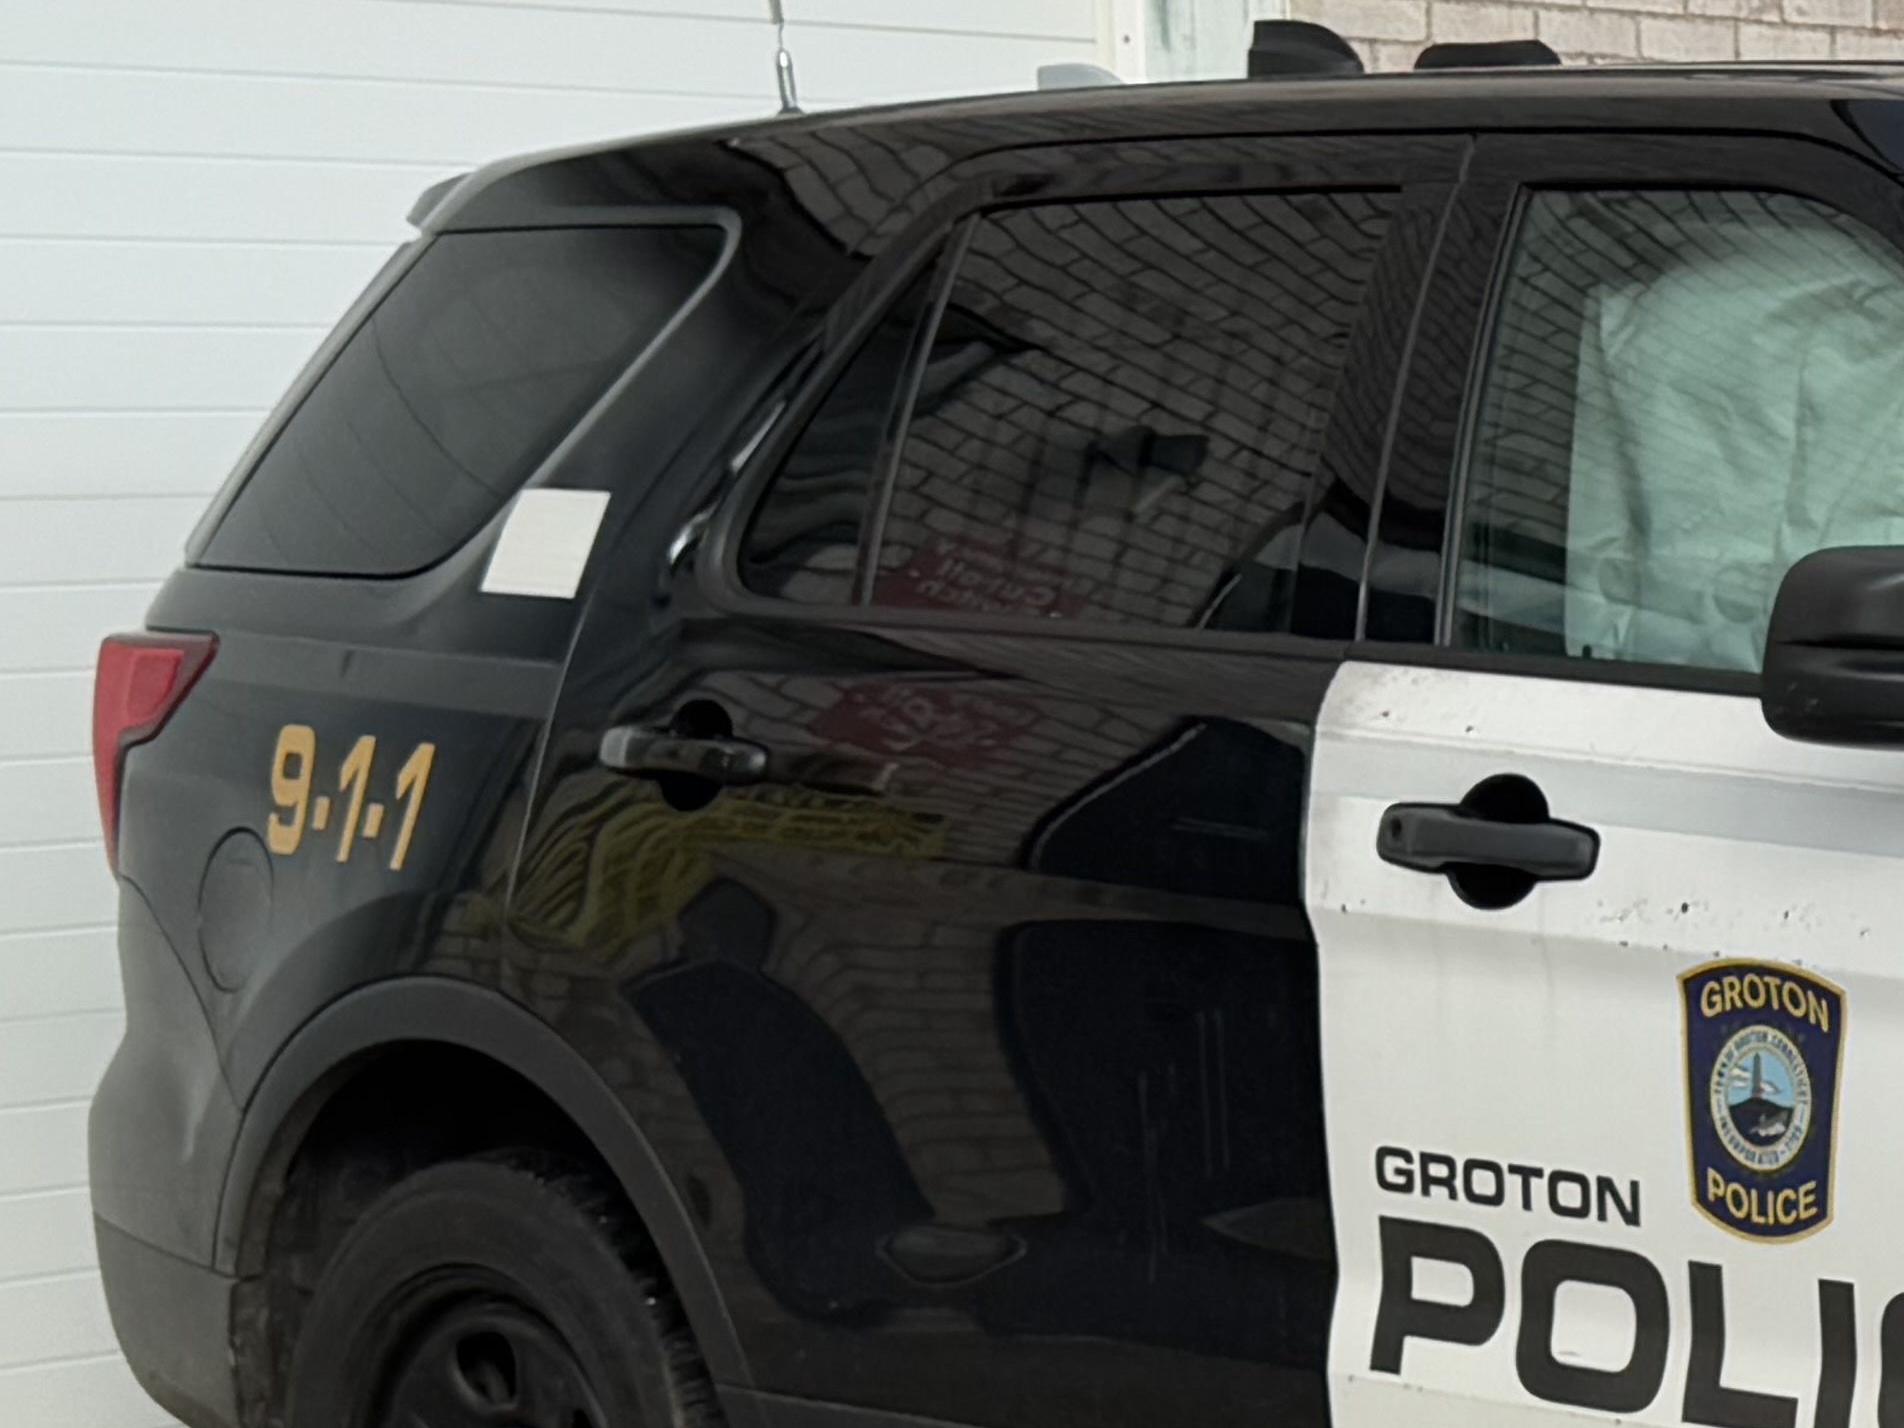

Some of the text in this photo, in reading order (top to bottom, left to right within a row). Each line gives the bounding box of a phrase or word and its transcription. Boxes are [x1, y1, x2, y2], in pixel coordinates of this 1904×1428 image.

[1701, 974, 1831, 1033] GROTON
[1374, 1145, 1641, 1228] GROTON
[1706, 1167, 1819, 1226] POLICE
